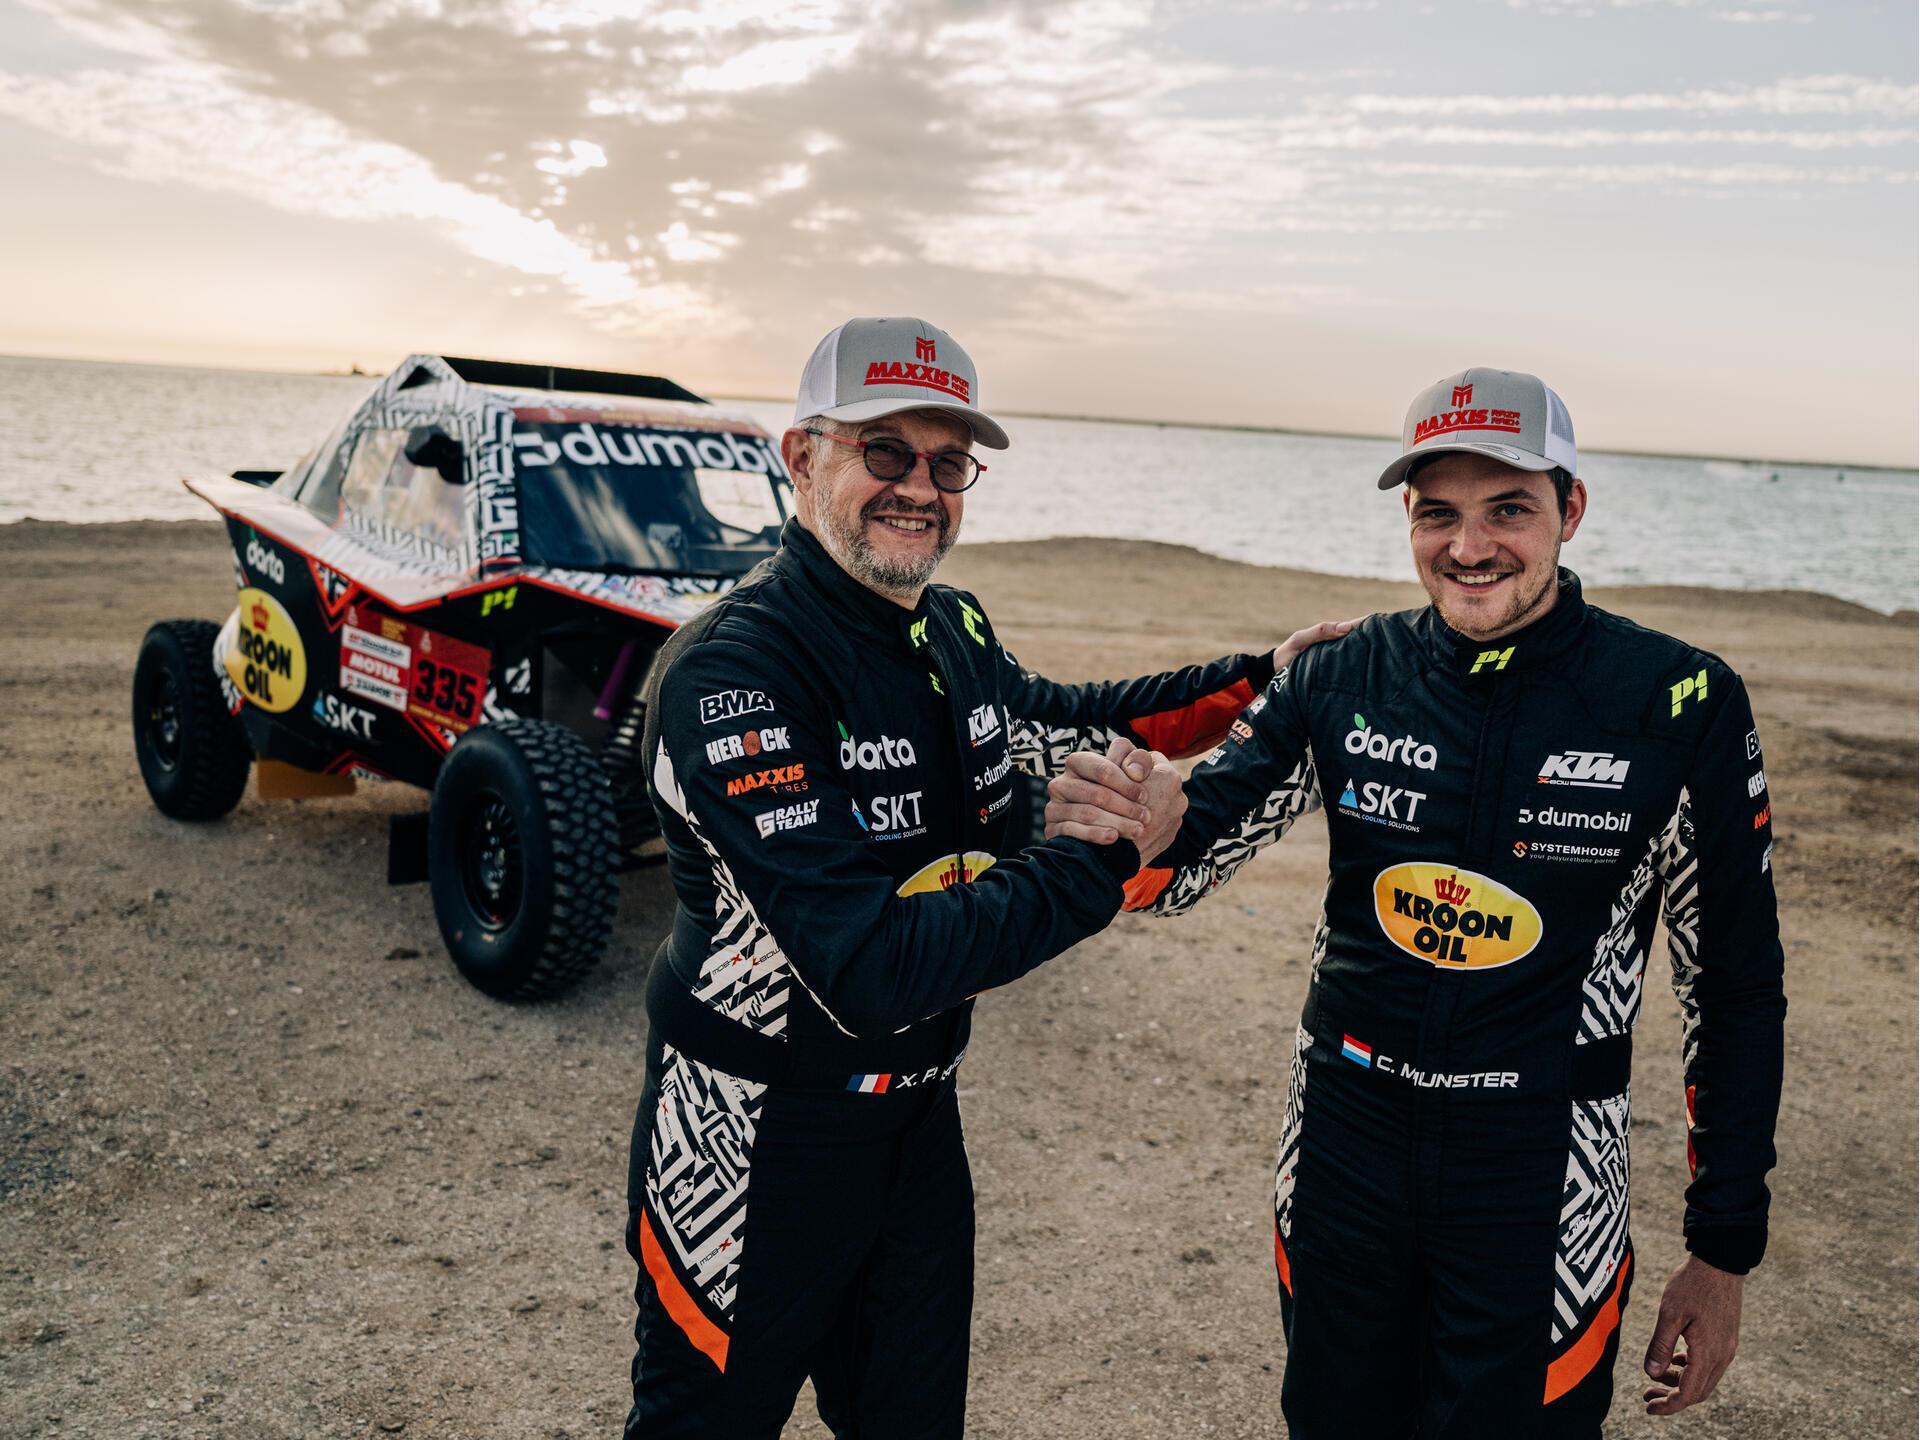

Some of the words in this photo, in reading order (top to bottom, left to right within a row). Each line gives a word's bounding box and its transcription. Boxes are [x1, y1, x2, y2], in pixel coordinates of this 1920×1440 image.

[866, 362, 950, 387] MAXXIS
[1413, 409, 1490, 439] MAXXIS
[561, 423, 790, 481] dumobil
[246, 540, 285, 585] darta
[482, 587, 518, 617] P1
[350, 652, 401, 683] MOTUL
[1469, 645, 1517, 674] P1
[245, 664, 273, 705] OIL
[415, 659, 478, 719] 335
[1668, 668, 1708, 720] P1
[325, 694, 377, 740] SKT
[701, 690, 774, 725] BMA
[968, 704, 1000, 741] KTM
[840, 735, 917, 771] darta
[1344, 726, 1438, 772] darta
[726, 763, 806, 797] MAXXIS
[1537, 750, 1631, 783] KTM
[770, 781, 809, 794] TRES
[1359, 781, 1427, 823] SKT
[775, 798, 820, 821] RALLY
[775, 811, 818, 831] TEAM
[871, 790, 923, 832] SKT
[1361, 814, 1387, 826] COOLING
[1387, 820, 1420, 833] SOLUTIONS
[1538, 807, 1632, 832] dumobil
[874, 833, 902, 842] COOLING
[902, 827, 927, 839] SOLUTIONS
[1530, 842, 1621, 857] SYSTEMHOUSE
[1393, 887, 1513, 941] KROON
[1413, 926, 1468, 963] OIL
[895, 1073, 918, 1089] X.
[1376, 1055, 1396, 1074] C.
[1400, 1062, 1520, 1088] MUNSTER
